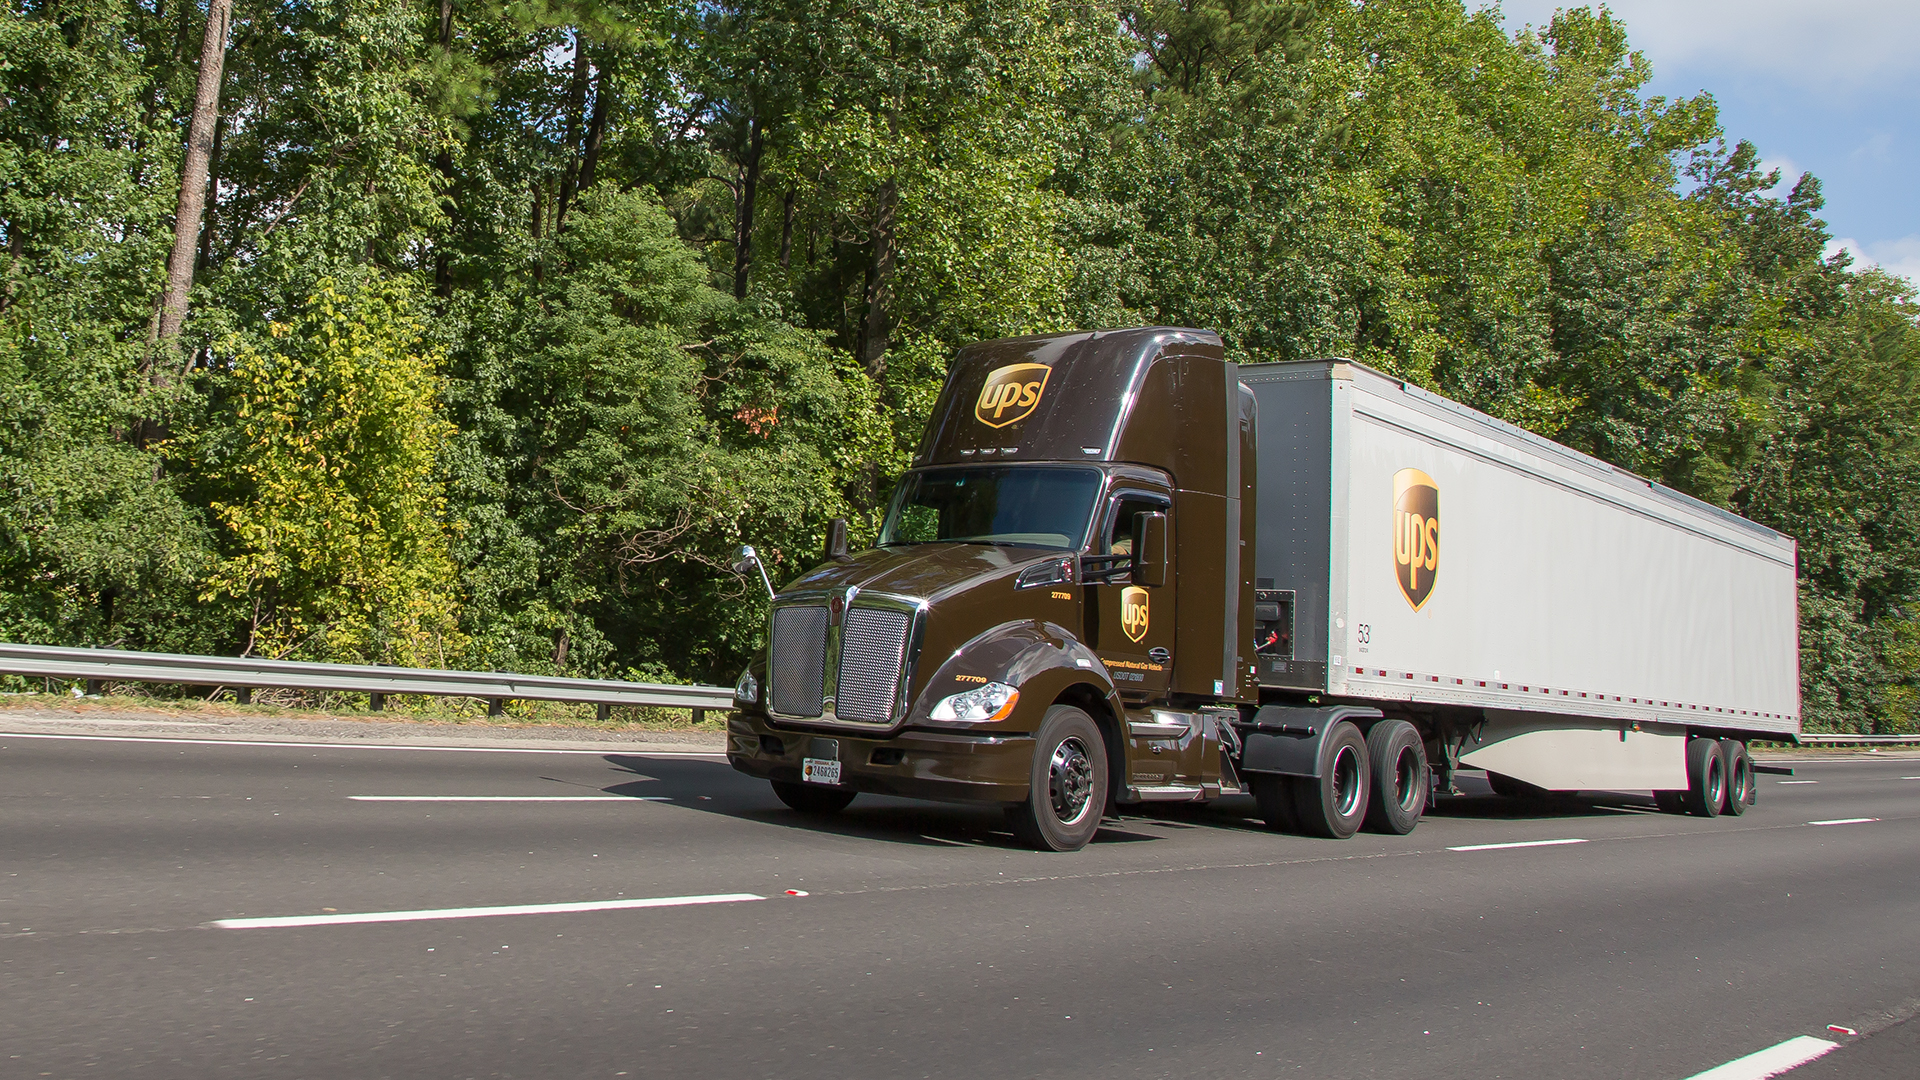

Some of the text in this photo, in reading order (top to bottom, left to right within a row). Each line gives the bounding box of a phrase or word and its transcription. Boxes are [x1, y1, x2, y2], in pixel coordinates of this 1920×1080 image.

[980, 381, 1041, 419] ups
[1396, 508, 1438, 590] ups
[1124, 604, 1147, 633] ups
[955, 674, 987, 683] 277709
